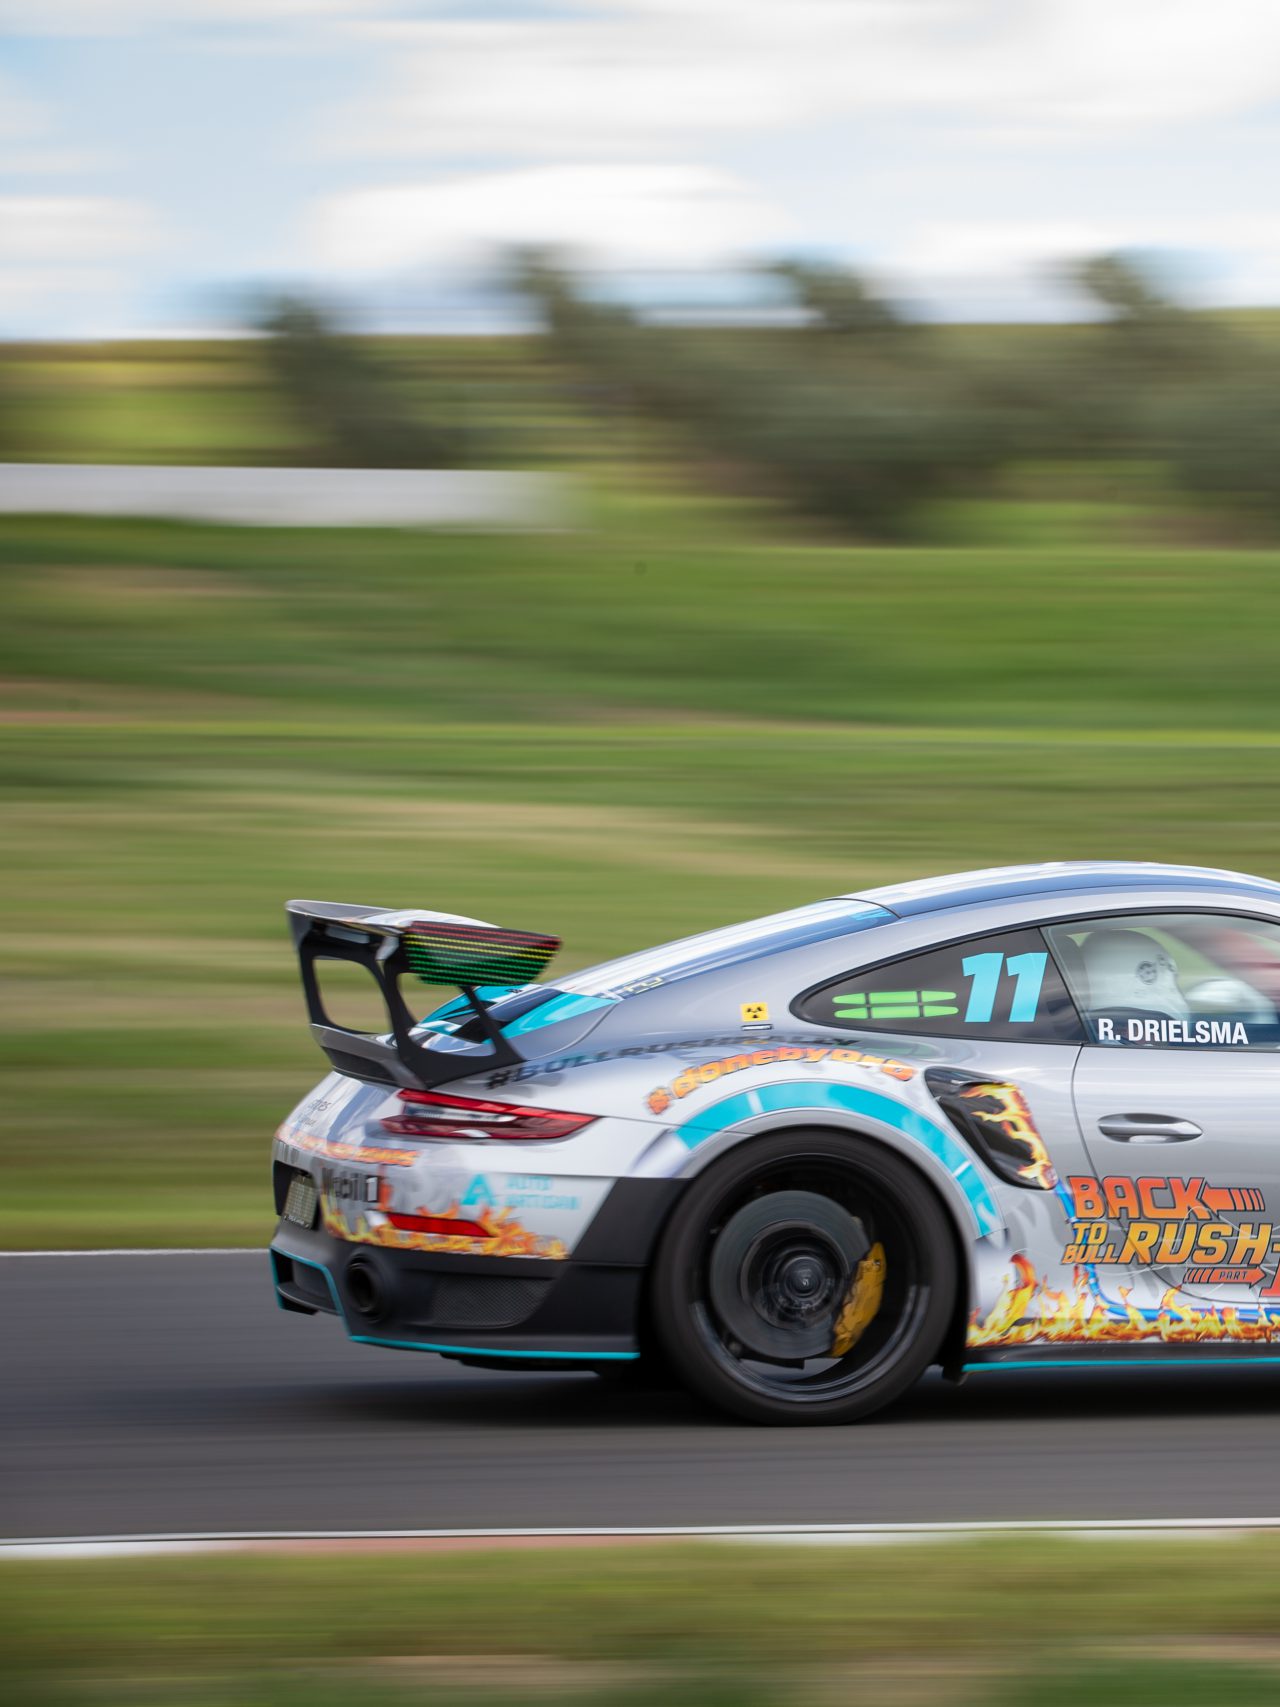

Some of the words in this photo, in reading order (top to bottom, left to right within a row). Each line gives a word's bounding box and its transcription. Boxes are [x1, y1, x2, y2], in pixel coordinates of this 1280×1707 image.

[962, 952, 1048, 1022] 11
[1098, 1018, 1121, 1041] R.
[1128, 1019, 1249, 1044] DRIELSMA
[1067, 1175, 1212, 1221] BACK
[1061, 1243, 1119, 1264] BULL
[1117, 1221, 1273, 1264] RUSH
[1073, 1221, 1108, 1245] TO
[1218, 1270, 1249, 1281] PART
